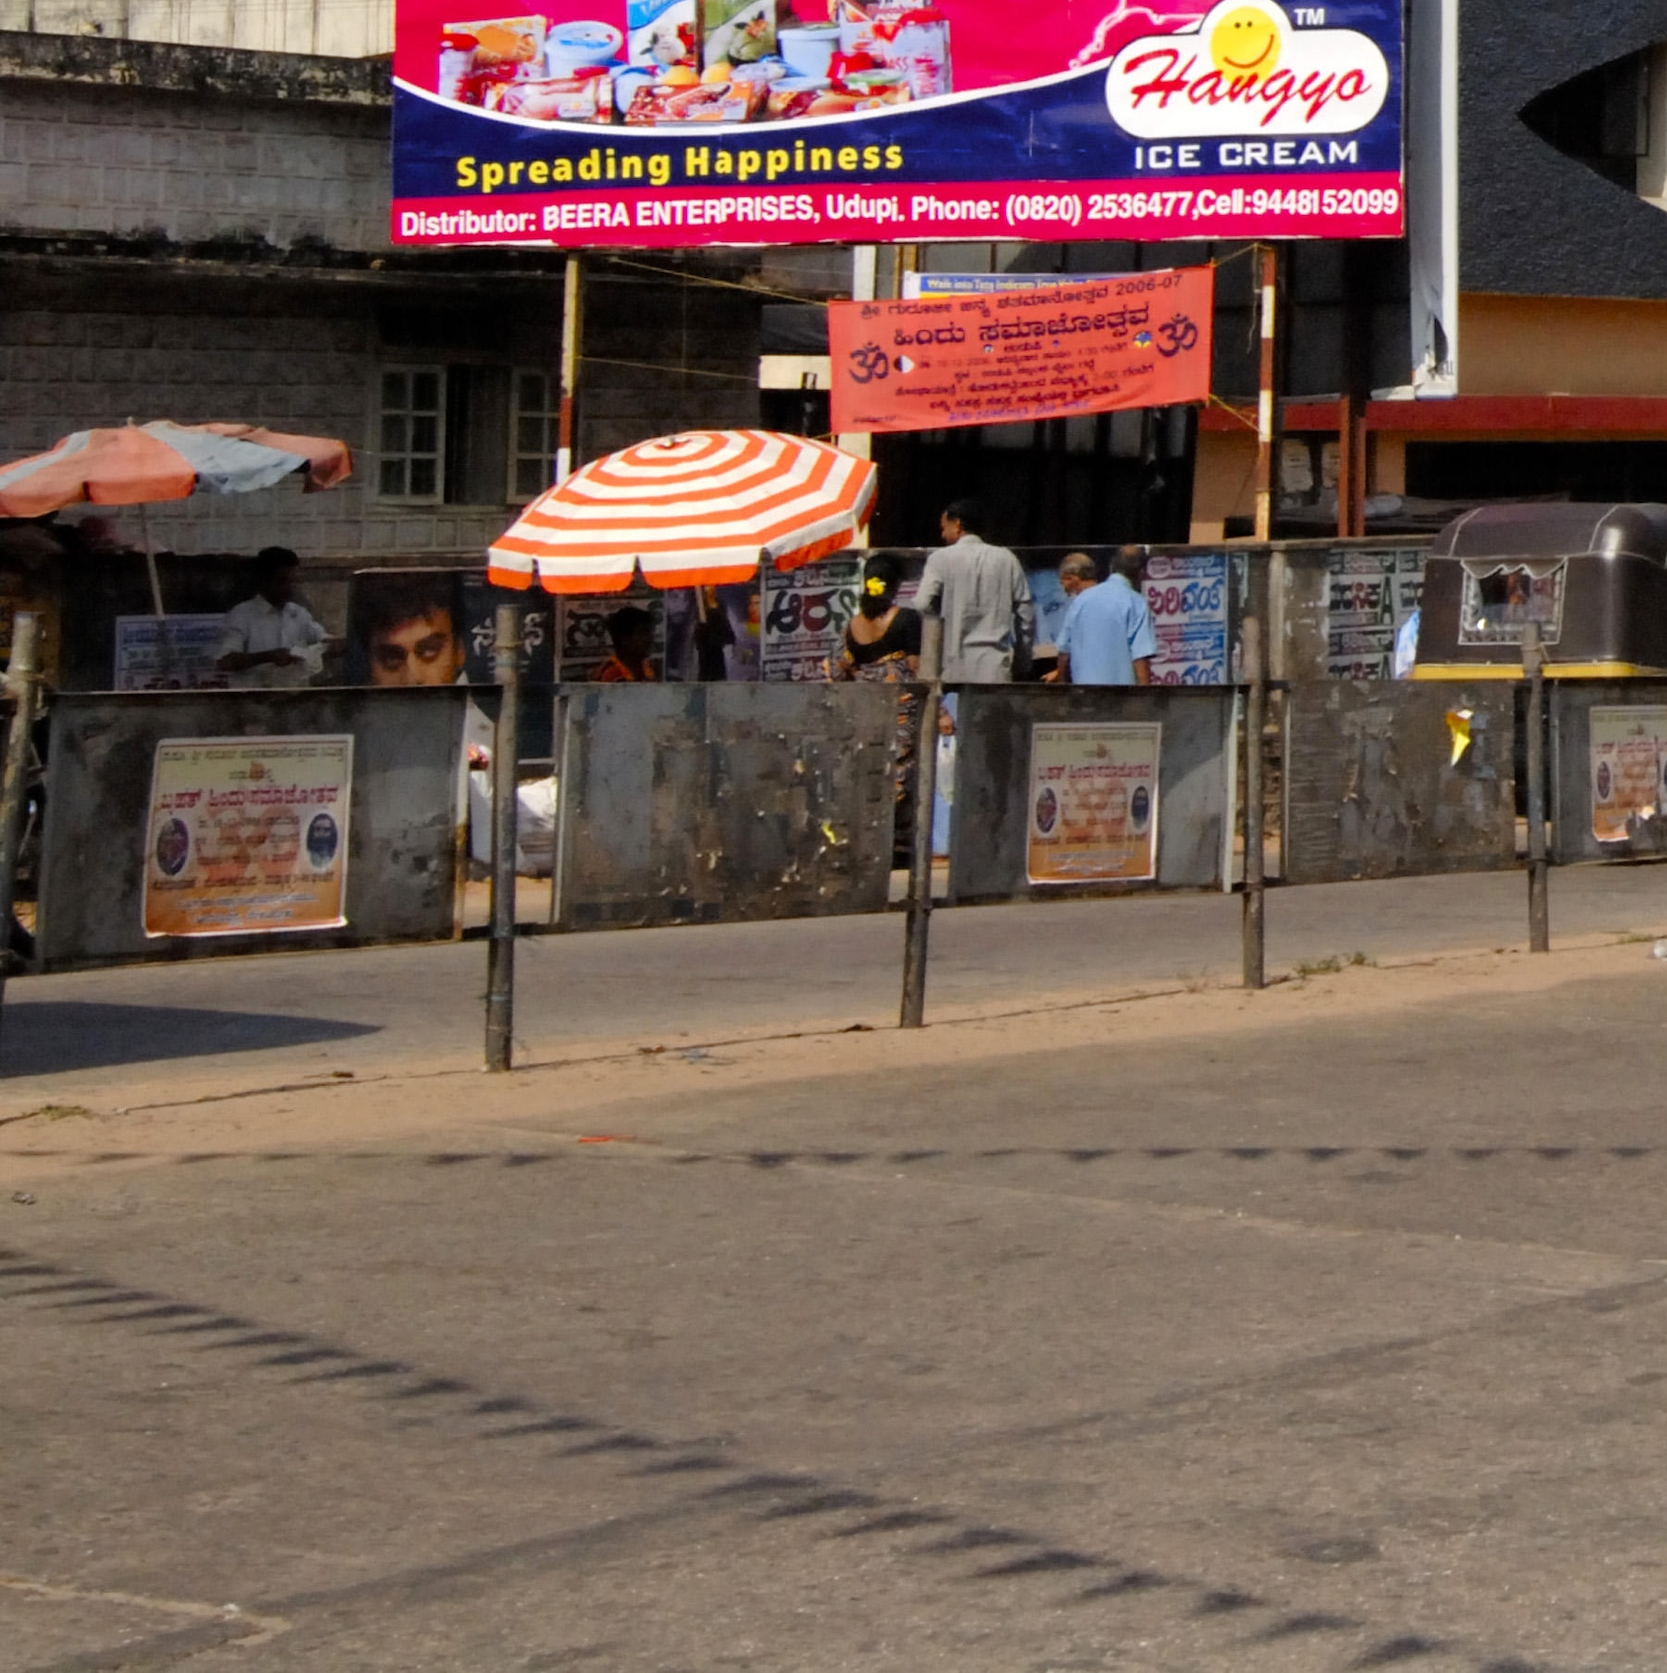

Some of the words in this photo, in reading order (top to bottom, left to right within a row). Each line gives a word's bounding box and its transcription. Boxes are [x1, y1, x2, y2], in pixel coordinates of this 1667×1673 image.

[1294, 8, 1325, 26] TM
[1123, 48, 1372, 127] Hangyo
[456, 150, 670, 193] Spreading
[685, 140, 903, 181] Happiness
[1135, 144, 1201, 170] ICE
[1219, 140, 1358, 167] CREAM
[401, 209, 537, 236] Distributor:
[542, 201, 630, 231] BEERA
[636, 194, 820, 227] ENTERPRISES,
[911, 195, 1000, 221] Phone:
[1005, 193, 1082, 226] (0820)
